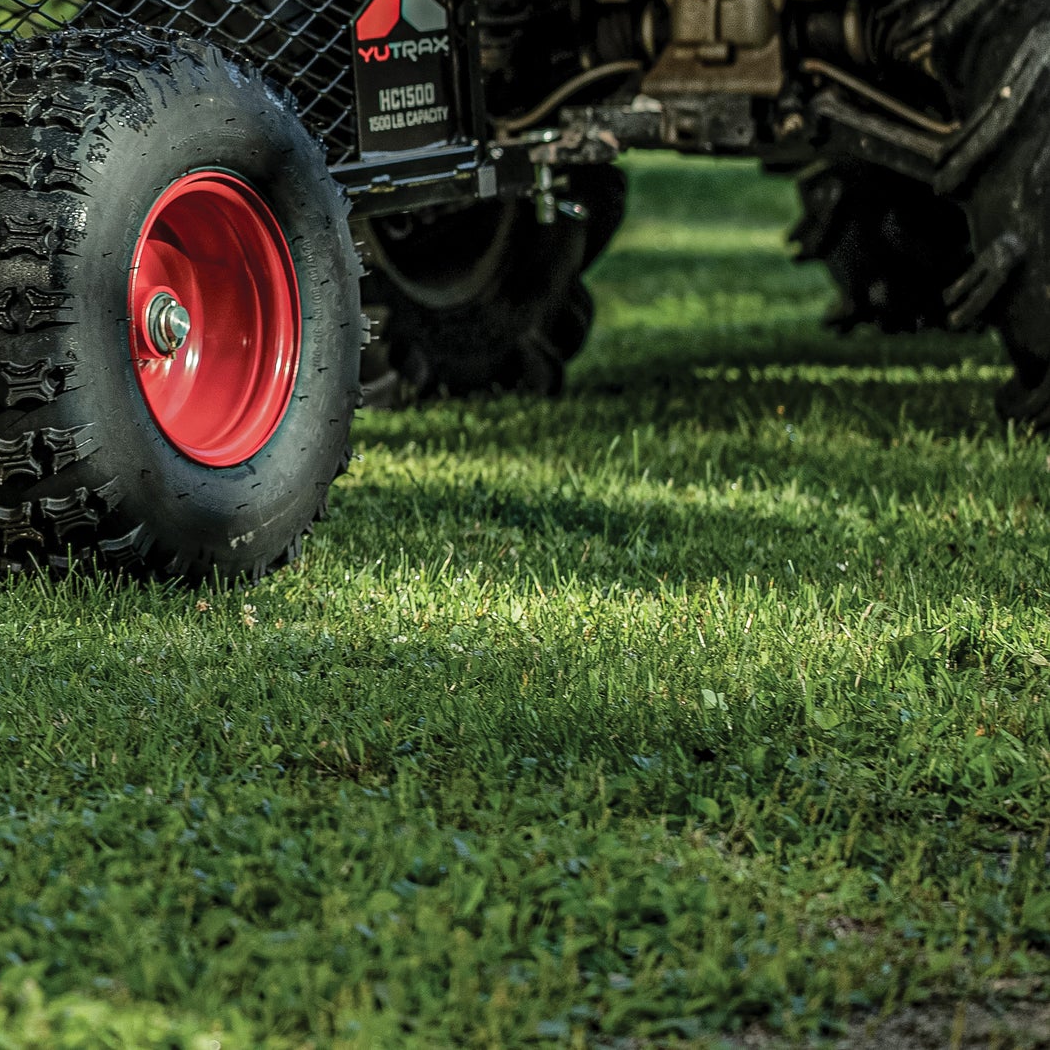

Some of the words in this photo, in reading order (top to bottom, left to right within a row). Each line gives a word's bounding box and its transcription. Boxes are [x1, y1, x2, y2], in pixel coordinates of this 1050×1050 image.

[358, 36, 449, 62] YUTRAX
[379, 83, 435, 111] HC1500
[369, 115, 390, 131] 1500
[406, 106, 448, 126] CAPACITY
